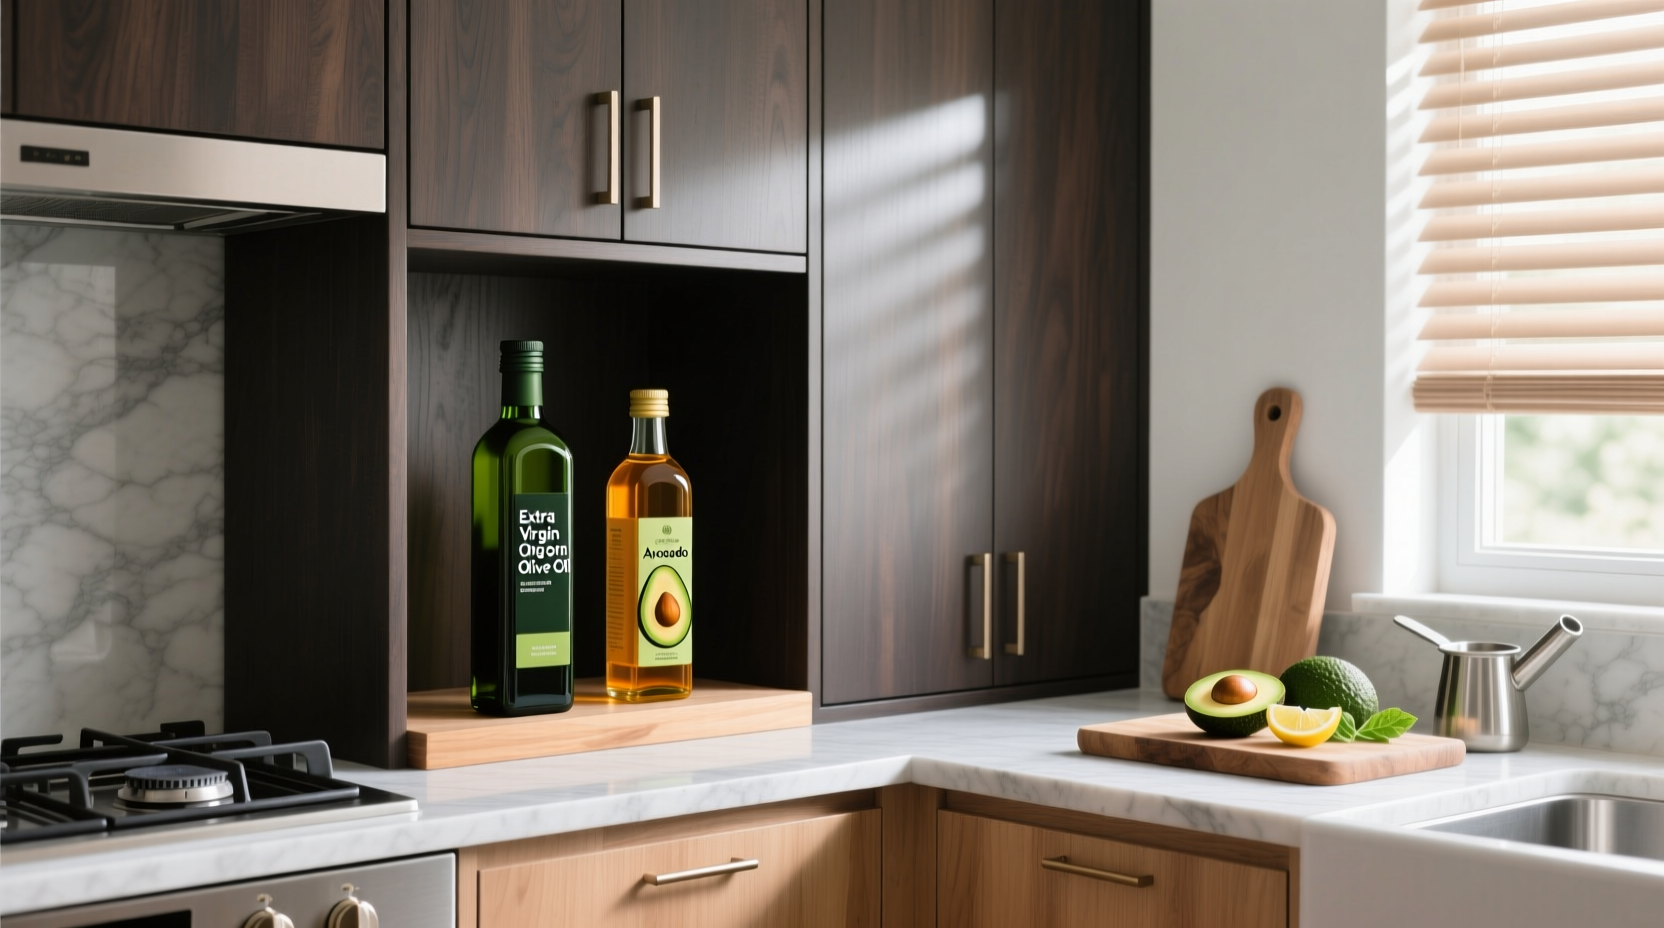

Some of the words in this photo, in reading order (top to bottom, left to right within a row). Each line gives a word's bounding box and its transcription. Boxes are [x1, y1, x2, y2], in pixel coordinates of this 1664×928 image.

[519, 509, 555, 524] Extra
[519, 525, 560, 544] Virgin
[518, 559, 551, 574] Olive
